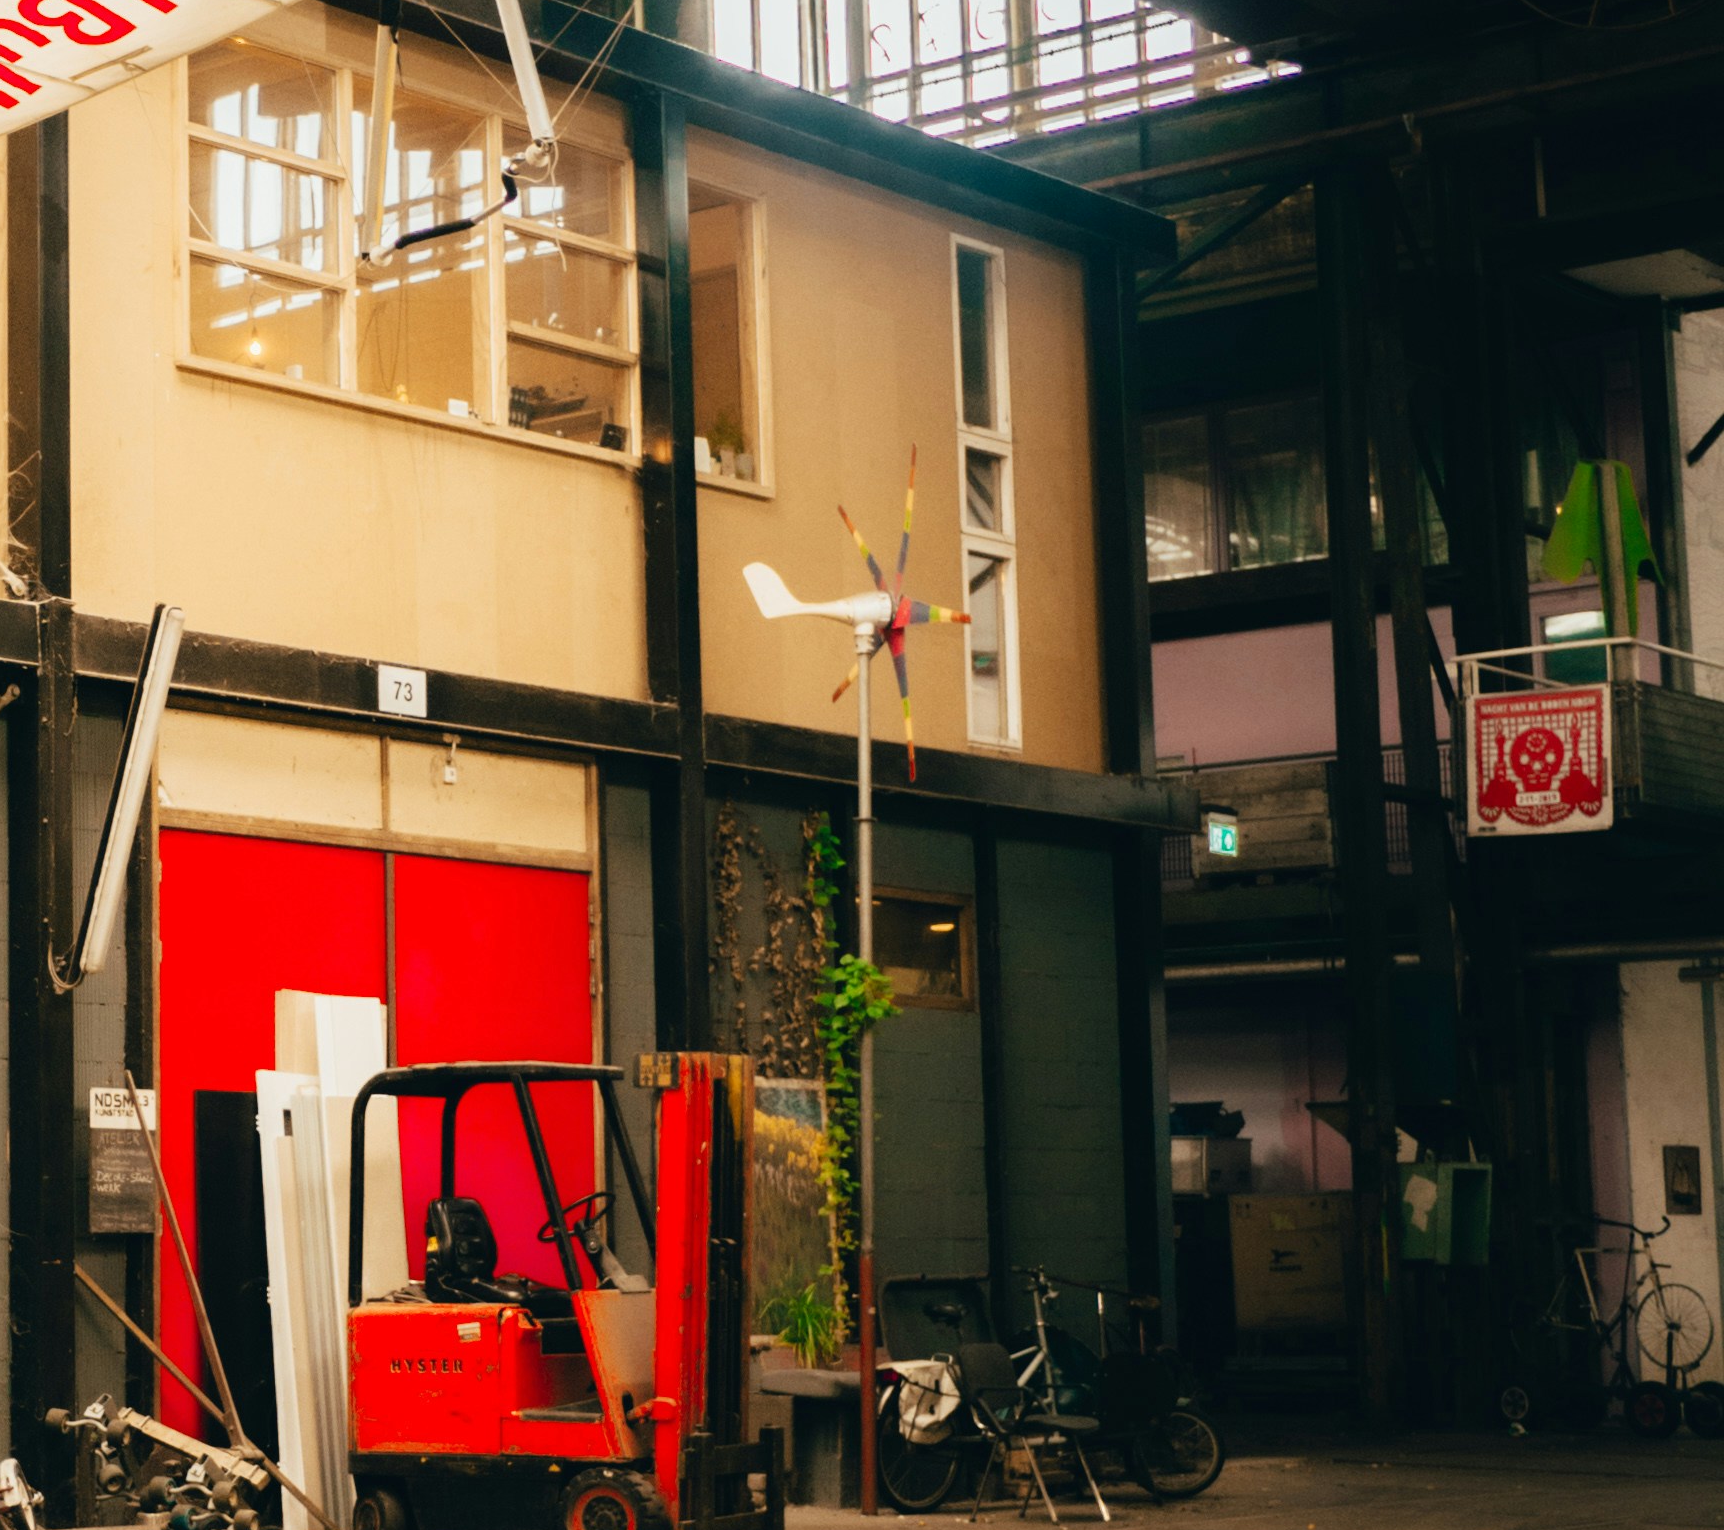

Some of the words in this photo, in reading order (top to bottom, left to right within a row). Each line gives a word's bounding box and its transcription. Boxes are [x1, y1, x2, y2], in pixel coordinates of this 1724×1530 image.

[393, 680, 413, 702] 73
[1509, 702, 1526, 713] VAN
[95, 1093, 135, 1108] NDSM
[390, 1359, 463, 1374] HYSTER
